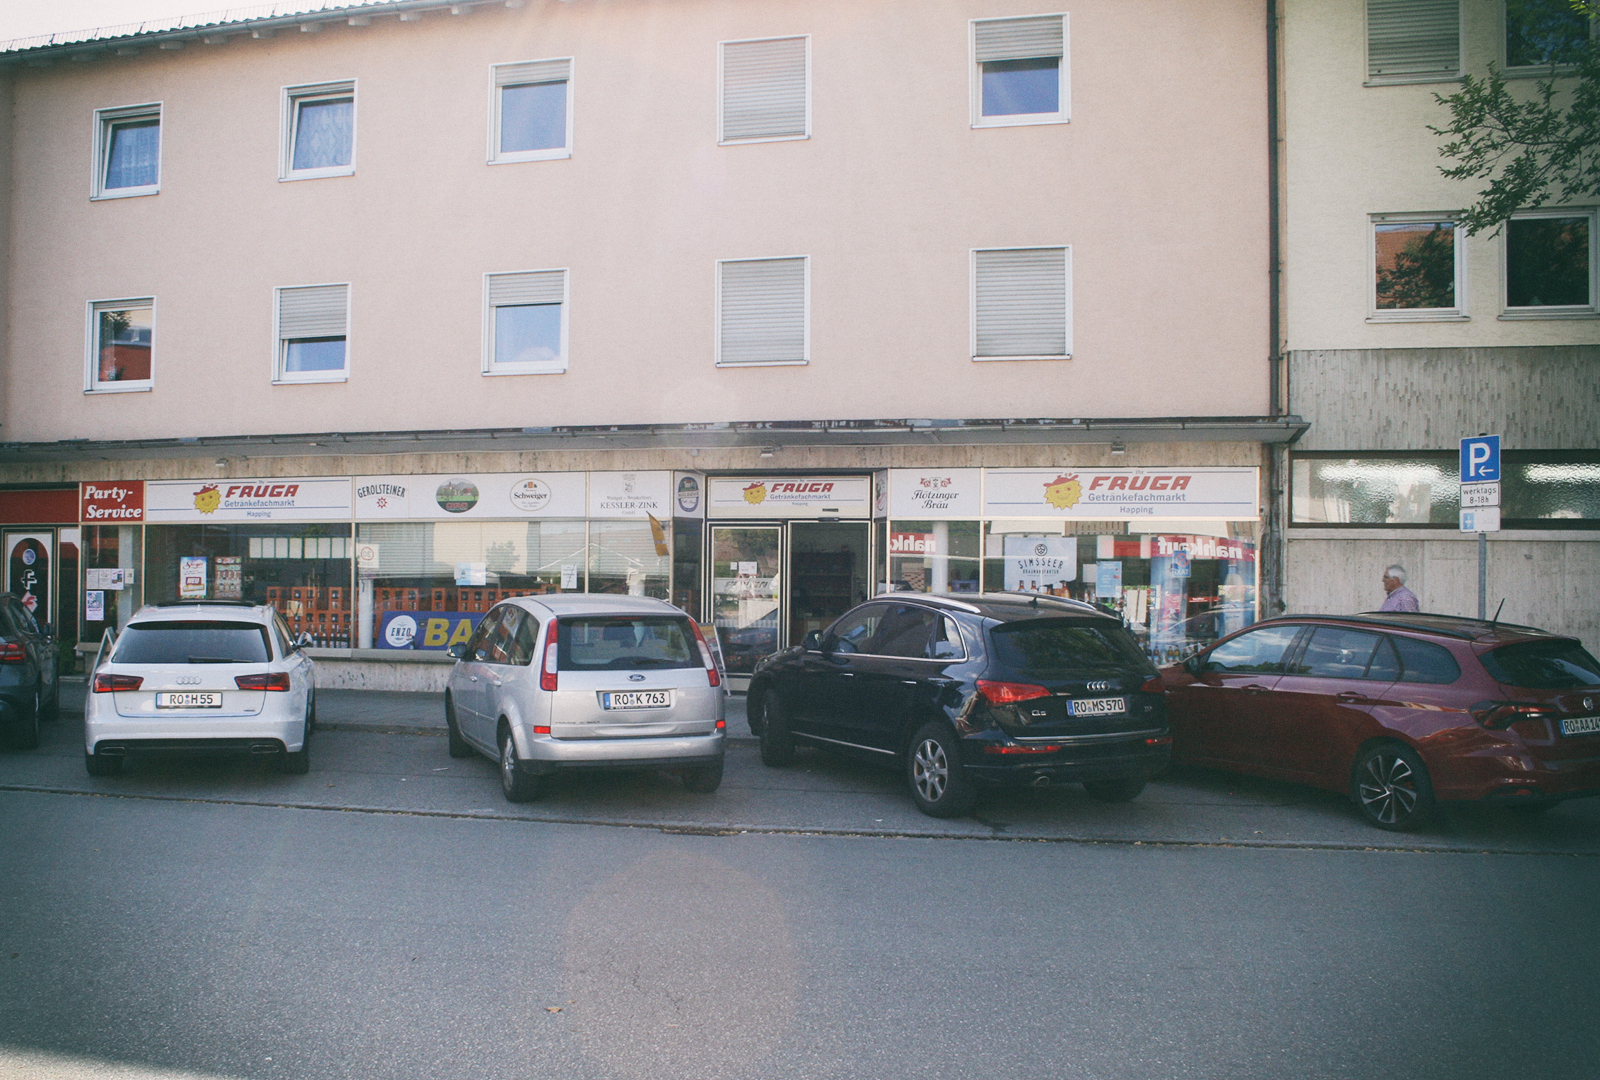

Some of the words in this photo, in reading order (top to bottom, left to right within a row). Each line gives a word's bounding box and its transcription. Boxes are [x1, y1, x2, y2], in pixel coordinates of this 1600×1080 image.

[1469, 442, 1491, 477] P
[770, 483, 835, 493] FRUGA
[1088, 475, 1192, 491] FRUGA
[84, 486, 134, 502] Party-
[225, 485, 300, 498] FRUGA
[357, 484, 406, 498] GEROLSTEINER
[513, 492, 548, 500] Schweiger
[911, 489, 960, 501] Flötzinger
[1462, 487, 1497, 495] werktags
[1088, 492, 1186, 502] Getränkefachmarkt
[1469, 496, 1490, 504] 8-18h
[921, 500, 949, 509] Bräu
[1119, 506, 1154, 514] Happing
[86, 504, 142, 519] Service
[1018, 557, 1064, 570] SIMSSEER
[390, 627, 411, 636] ENZO
[170, 695, 184, 704] RO
[614, 694, 629, 705] RO
[1073, 701, 1087, 713] RO
[1563, 720, 1576, 733] RO
